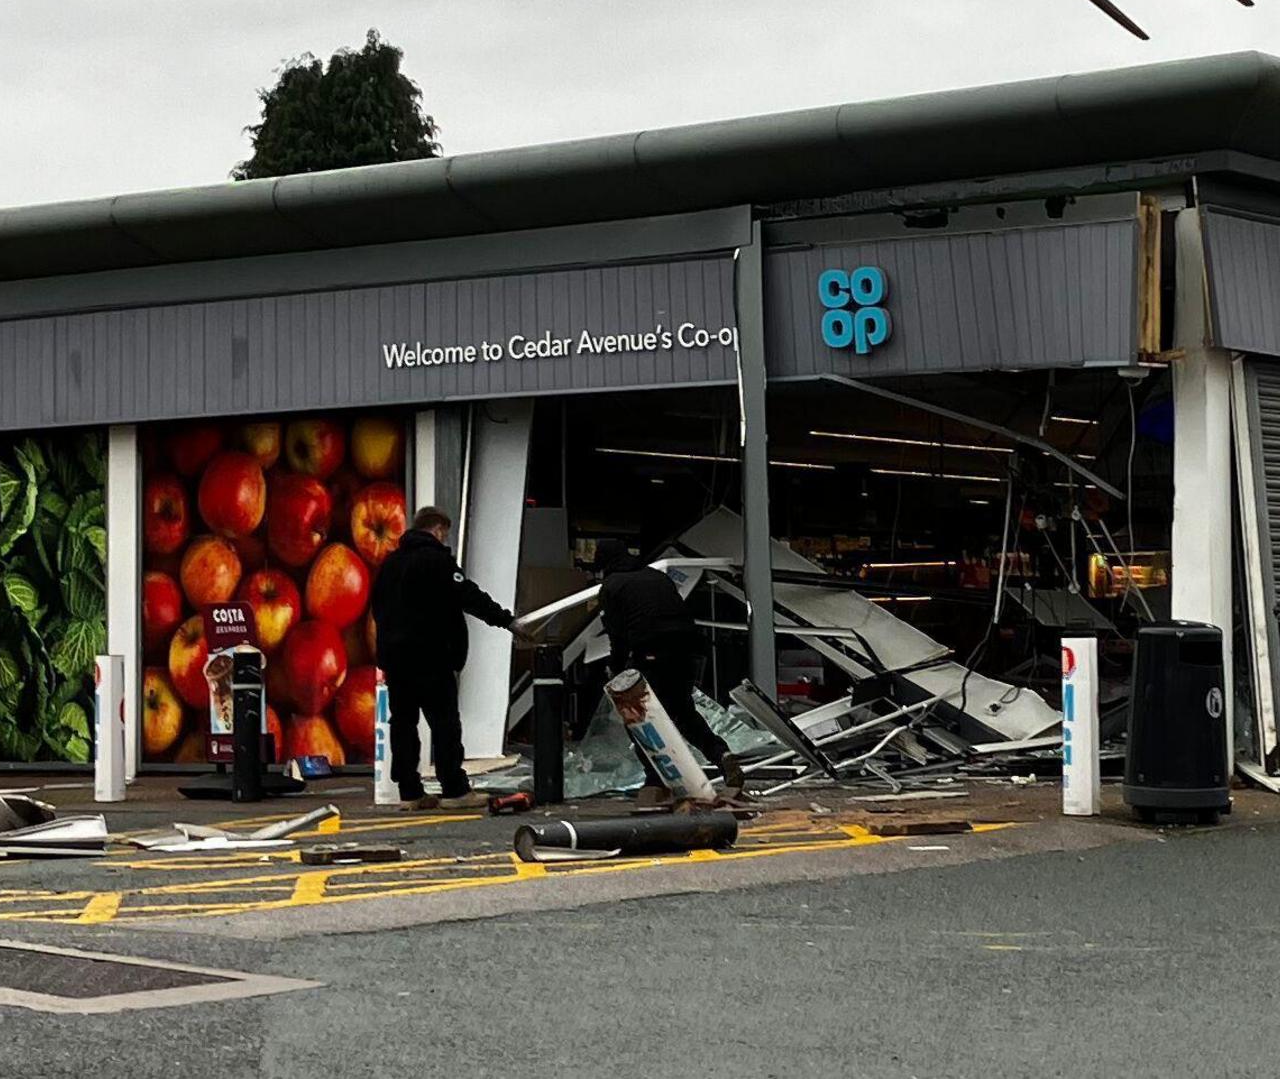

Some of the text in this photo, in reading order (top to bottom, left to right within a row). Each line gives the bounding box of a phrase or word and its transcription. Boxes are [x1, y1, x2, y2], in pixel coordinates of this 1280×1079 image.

[383, 341, 477, 369] Welcome
[481, 341, 503, 362] to
[508, 330, 571, 360] Cedar
[576, 324, 673, 354] Avenue's
[212, 608, 246, 624] COSTA
